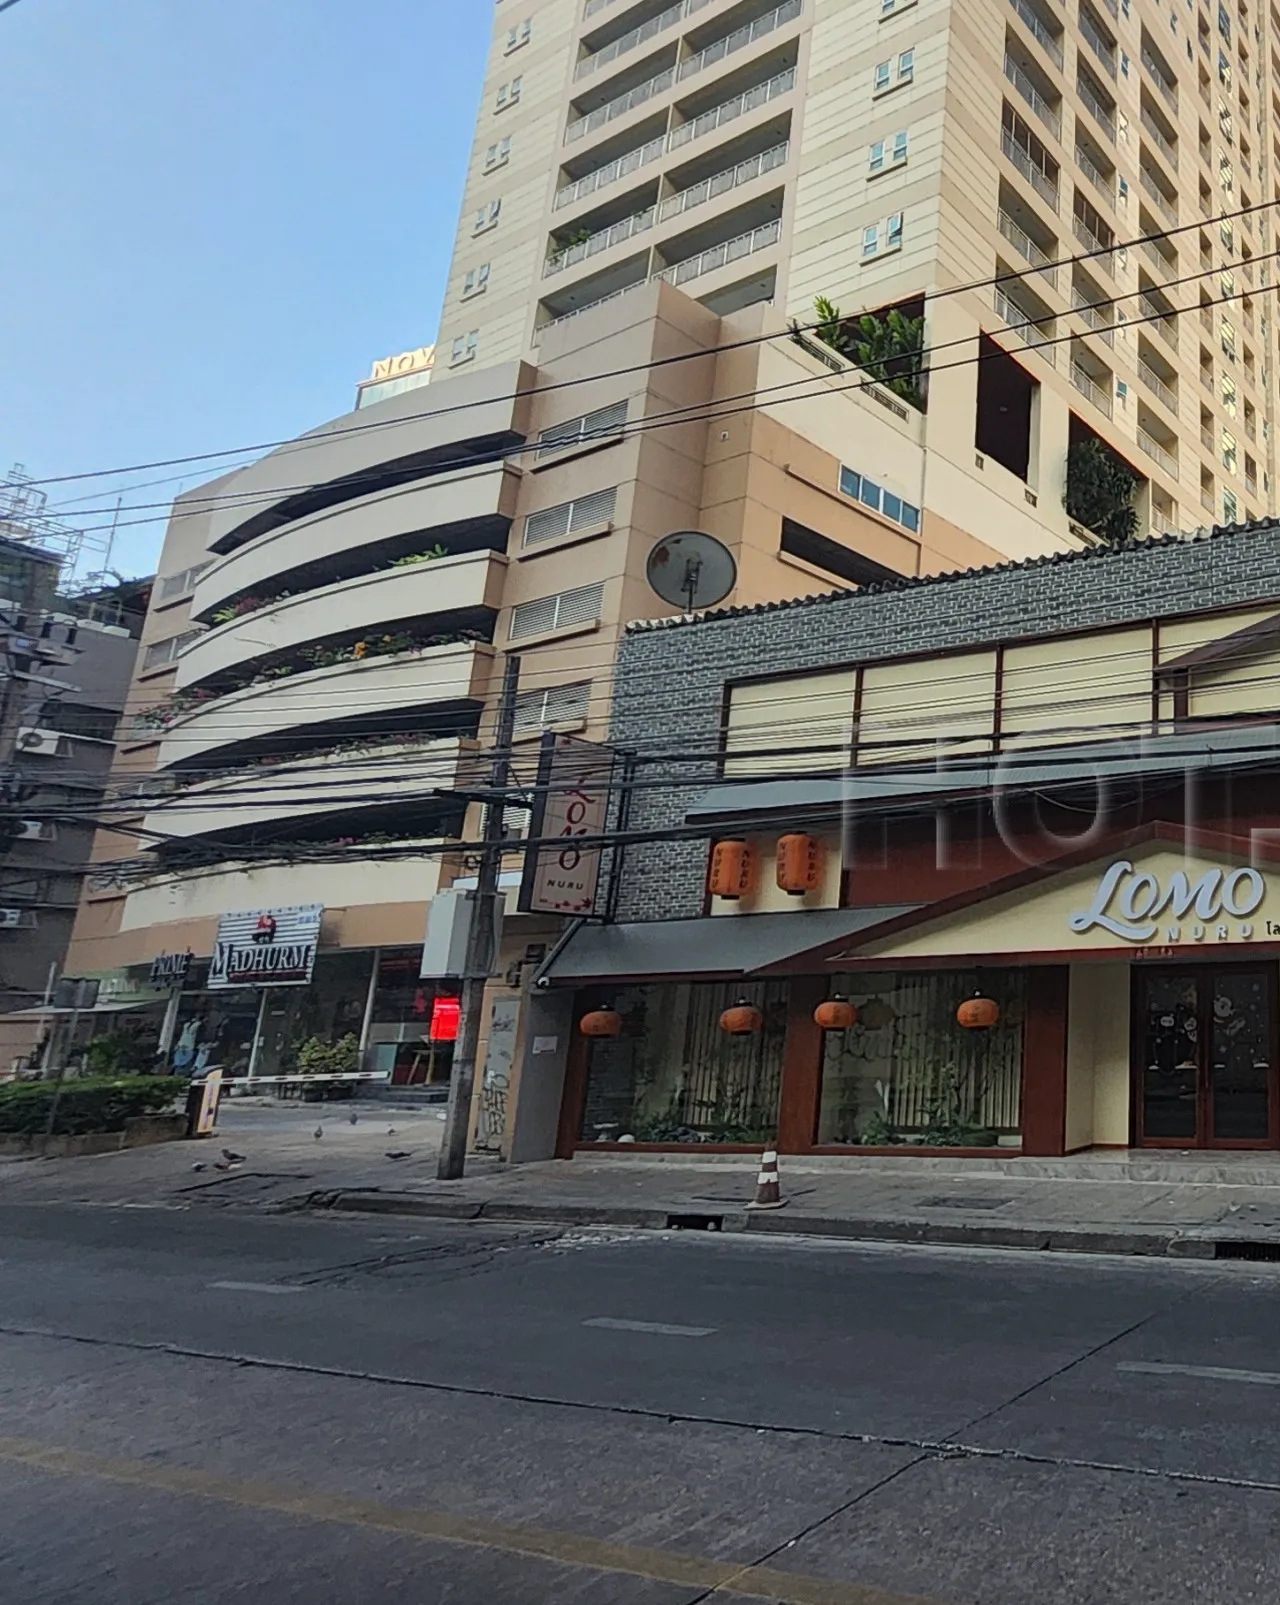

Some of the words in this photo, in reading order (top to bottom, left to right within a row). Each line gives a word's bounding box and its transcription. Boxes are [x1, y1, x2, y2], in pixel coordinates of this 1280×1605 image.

[547, 879, 584, 890] NURU
[1069, 860, 1267, 940] LOMO
[1166, 924, 1255, 943] NURU
